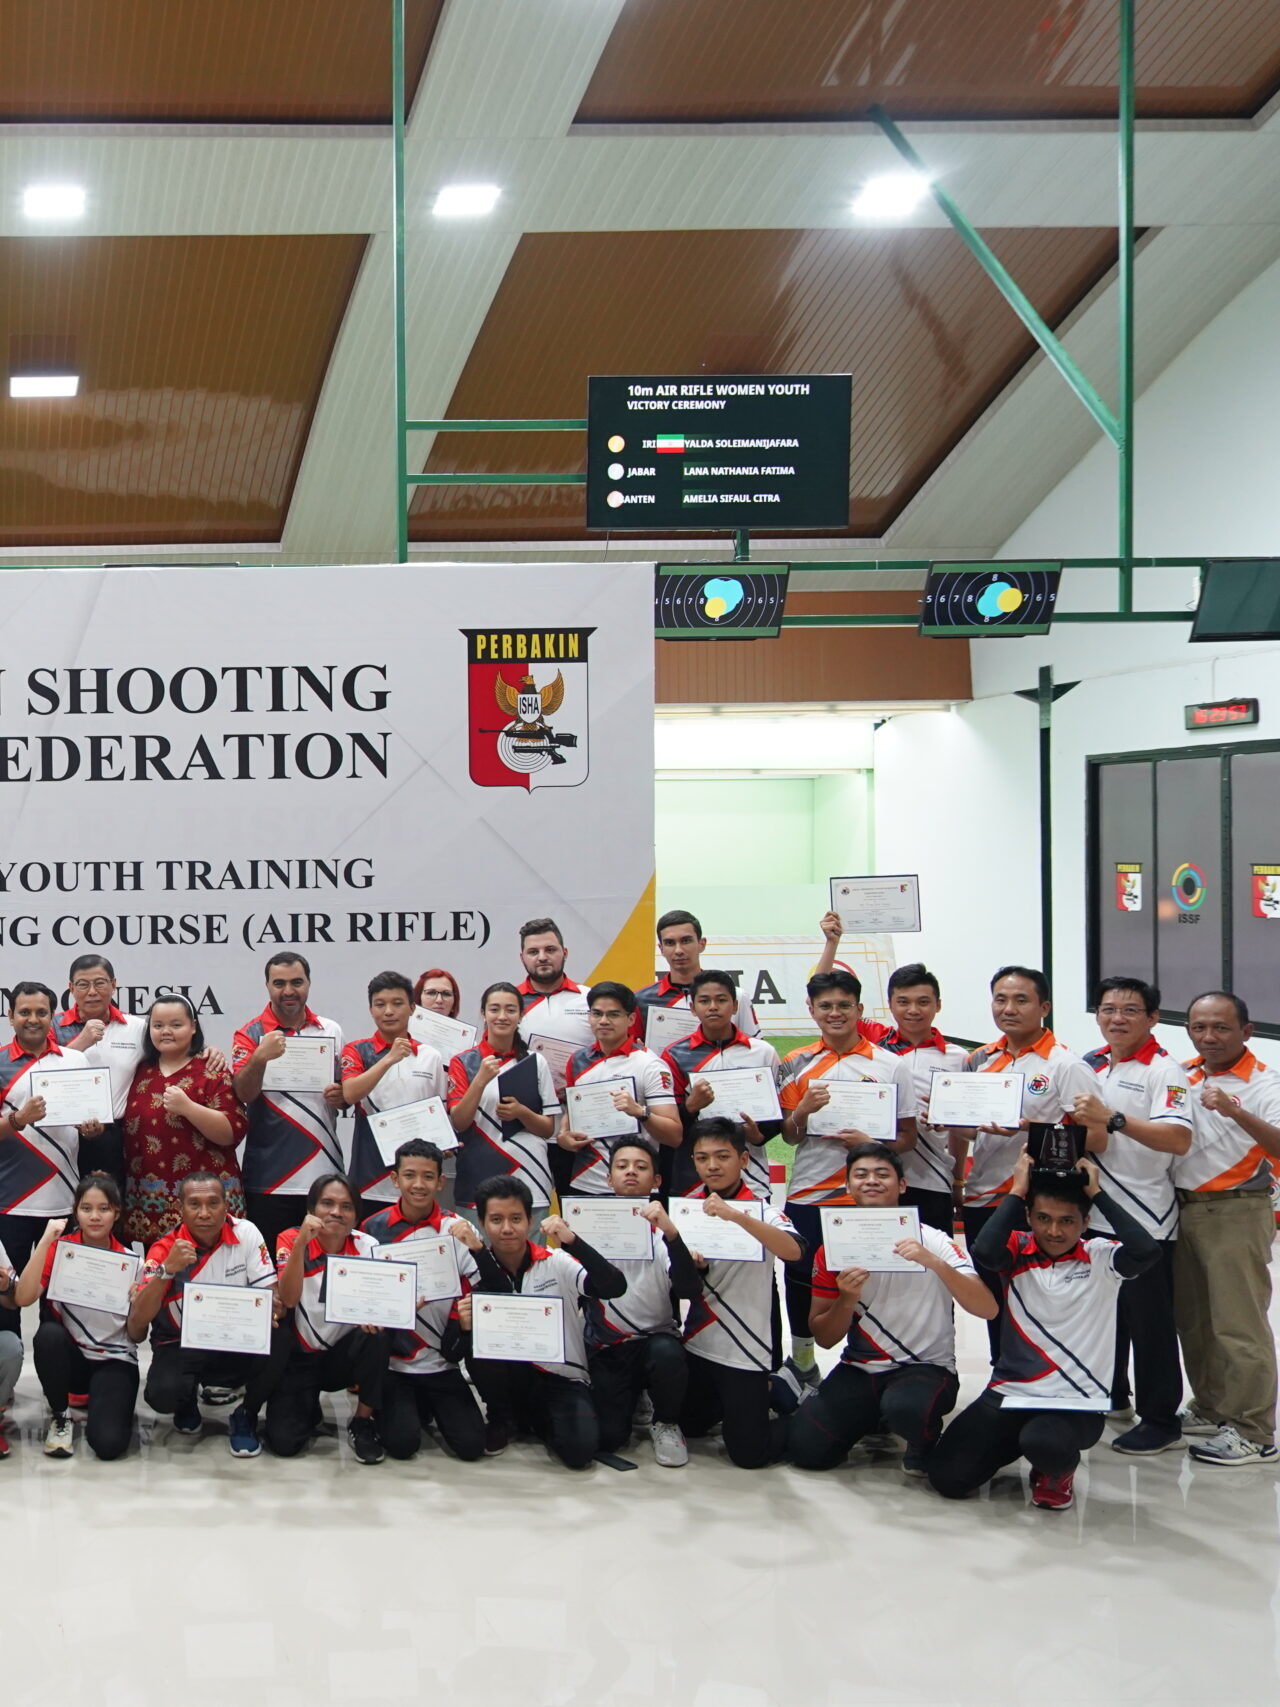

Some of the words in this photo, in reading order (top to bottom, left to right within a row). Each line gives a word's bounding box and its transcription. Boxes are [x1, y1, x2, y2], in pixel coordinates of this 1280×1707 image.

[627, 384, 654, 397] 10m
[655, 384, 678, 396] AIR
[680, 384, 714, 396] RIFLE
[715, 384, 765, 396] WOMEN
[767, 383, 810, 396] YOUTH
[626, 400, 670, 410] VICTORY
[671, 400, 727, 410] CEREMONY
[642, 439, 657, 448] IRI
[684, 439, 714, 448] YALDA
[626, 467, 656, 478] JABAR
[683, 467, 710, 476] LANA
[710, 466, 760, 476] NATHANIA
[760, 466, 796, 475] FATIMA
[620, 494, 656, 504] ANTEN
[682, 495, 719, 504] AMELIA
[719, 494, 752, 503] SIFAUL
[752, 494, 781, 503] CITRA
[664, 597, 671, 605] 5
[676, 597, 682, 605] 6
[687, 597, 693, 605] 7
[699, 597, 705, 605] 8
[925, 594, 933, 603] 5
[939, 594, 946, 603] 6
[953, 594, 960, 603] 7
[967, 594, 974, 603] 8
[1035, 593, 1042, 602] 6
[1049, 593, 1056, 602] 5
[476, 632, 580, 660] PERBAKIN
[27, 664, 392, 716] SHOOTING
[519, 696, 541, 715] ISHA
[156, 857, 376, 891] TRAINING
[51, 913, 229, 947] COURSE
[242, 911, 336, 952] (AIR
[346, 909, 492, 949] RIFLE)
